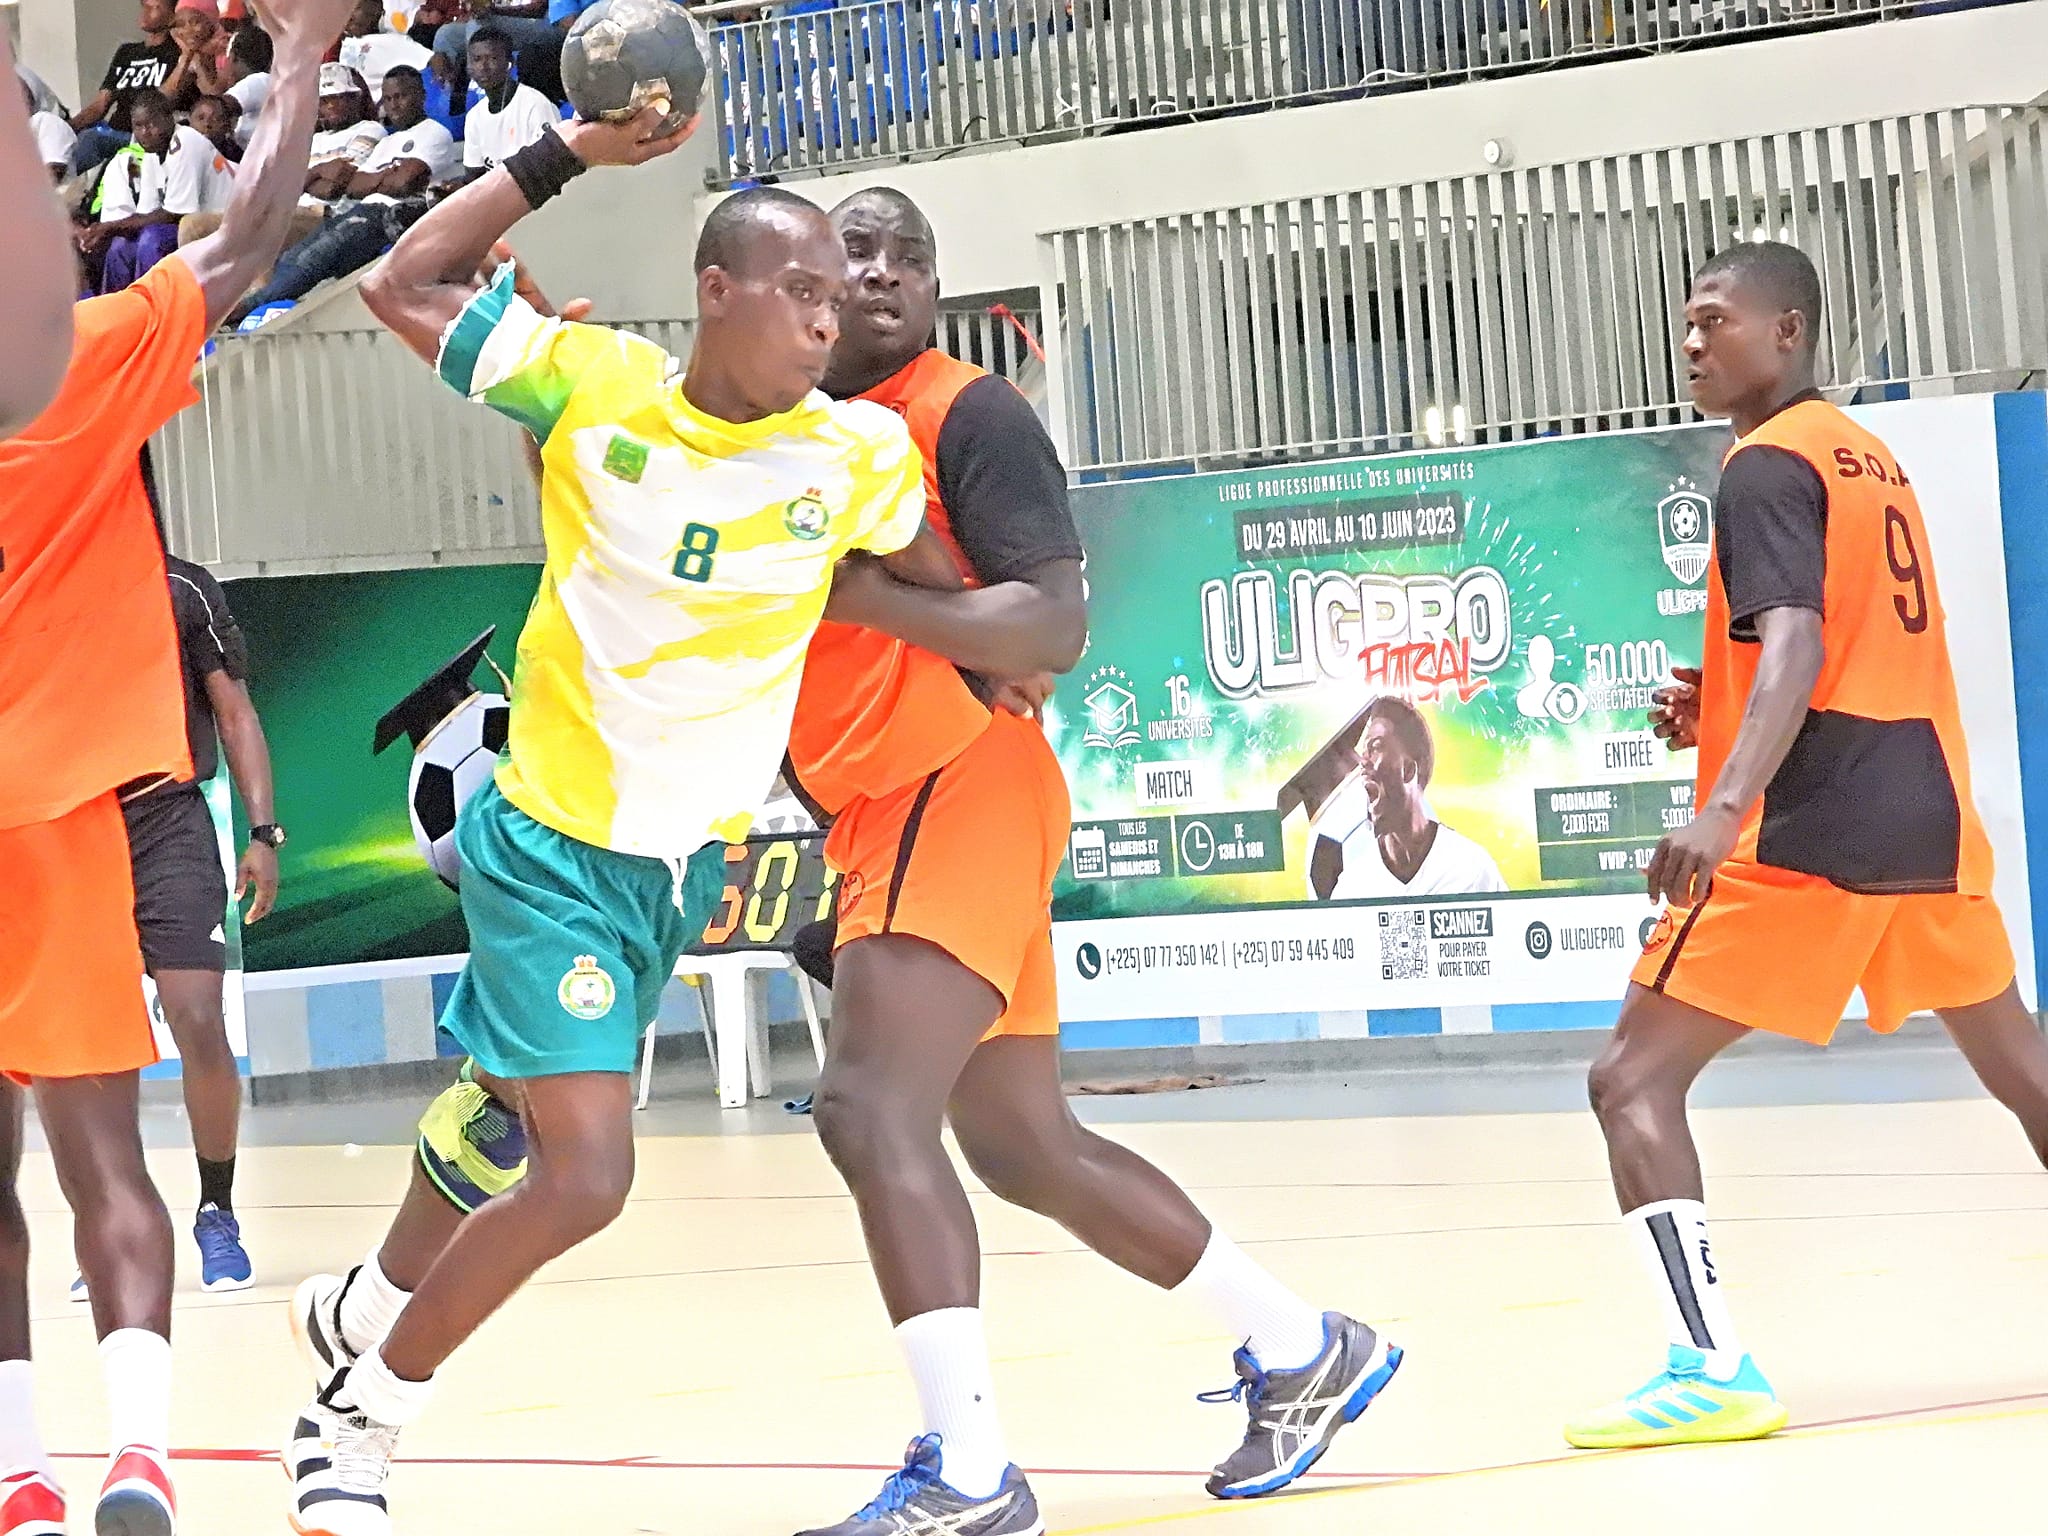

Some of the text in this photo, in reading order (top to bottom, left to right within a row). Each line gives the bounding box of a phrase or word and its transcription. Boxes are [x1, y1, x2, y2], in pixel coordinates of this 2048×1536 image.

[1219, 460, 1474, 502] LIGUE PROFESSIONNELLE DES UNIVERSITÉS
[1243, 506, 1456, 550] DU 29 AVRIL AU 10 JUIN 2023
[672, 522, 719, 583] 8
[1885, 505, 1928, 634] 9
[1656, 589, 1708, 616] ULIGPR
[1202, 566, 1512, 699] ULIGPRO
[1585, 639, 1668, 687] 50.000
[1164, 674, 1192, 718] 16
[1590, 686, 1660, 712] SPECTATEU
[1605, 735, 1653, 769] ENTRÉE
[1147, 769, 1193, 800] MATCH
[1118, 821, 1147, 836] TOUS LES
[1234, 823, 1245, 839] DE
[1109, 839, 1159, 857] SAMEDIS ET
[1218, 842, 1236, 860] 13H
[1110, 859, 1161, 877] DIMANCHES
[1433, 910, 1489, 936] SCANNEZ
[1271, 940, 1284, 962] 07
[1288, 939, 1303, 961] 59
[1306, 939, 1329, 961] 445
[1332, 938, 1354, 960] 409
[1439, 941, 1487, 958] POUR PAYER
[1560, 927, 1625, 951] ULIGUEPRO
[1143, 946, 1156, 968] 07
[1159, 945, 1171, 967] 77
[1175, 944, 1197, 966] 350
[1200, 943, 1218, 966] 142
[1437, 960, 1491, 977] VOTRE TICKET
